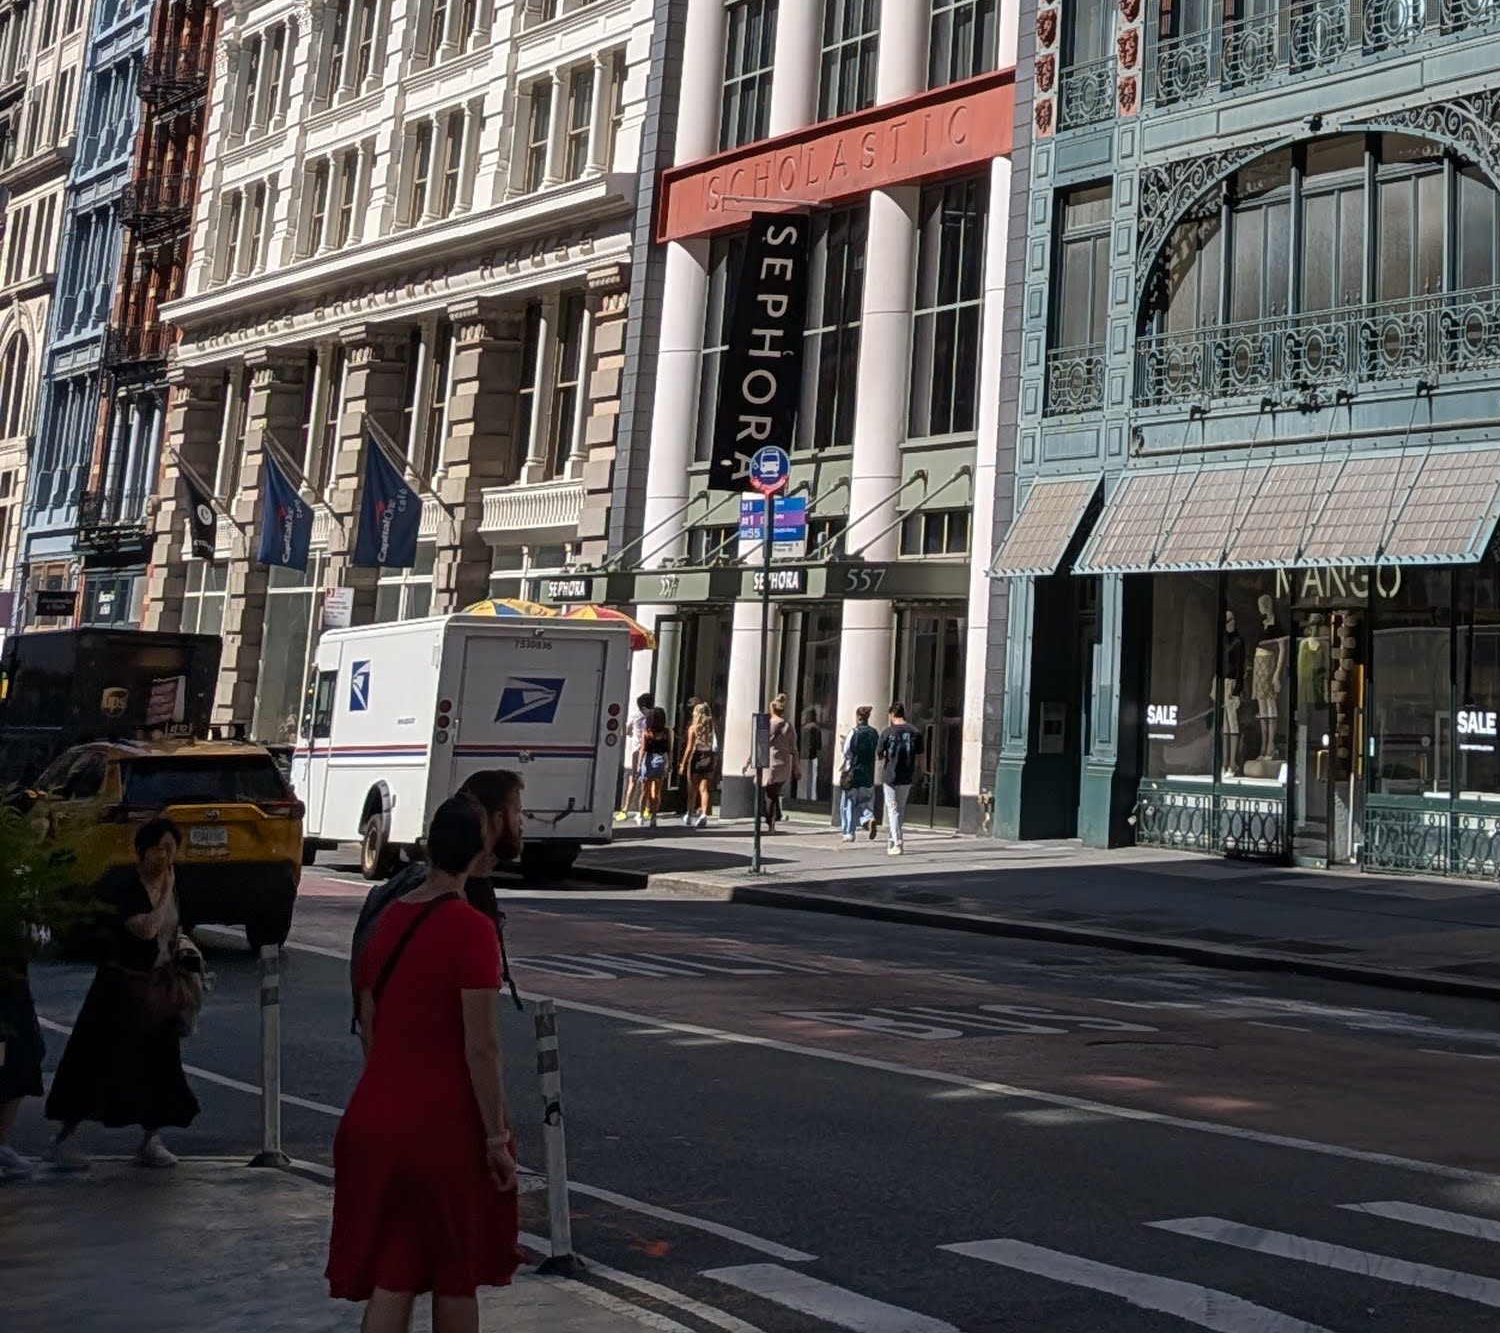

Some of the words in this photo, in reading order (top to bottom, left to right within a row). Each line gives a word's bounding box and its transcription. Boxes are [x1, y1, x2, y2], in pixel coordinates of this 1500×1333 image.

[706, 105, 967, 211] SCHOLASTIC
[731, 225, 797, 480] SEPHORA
[548, 580, 586, 598] SEPHORA
[754, 570, 799, 591] SEHORA
[844, 568, 888, 592] 557
[1146, 704, 1178, 726] SALE
[1456, 711, 1497, 735] SALE
[775, 1004, 1161, 1040] BUS
